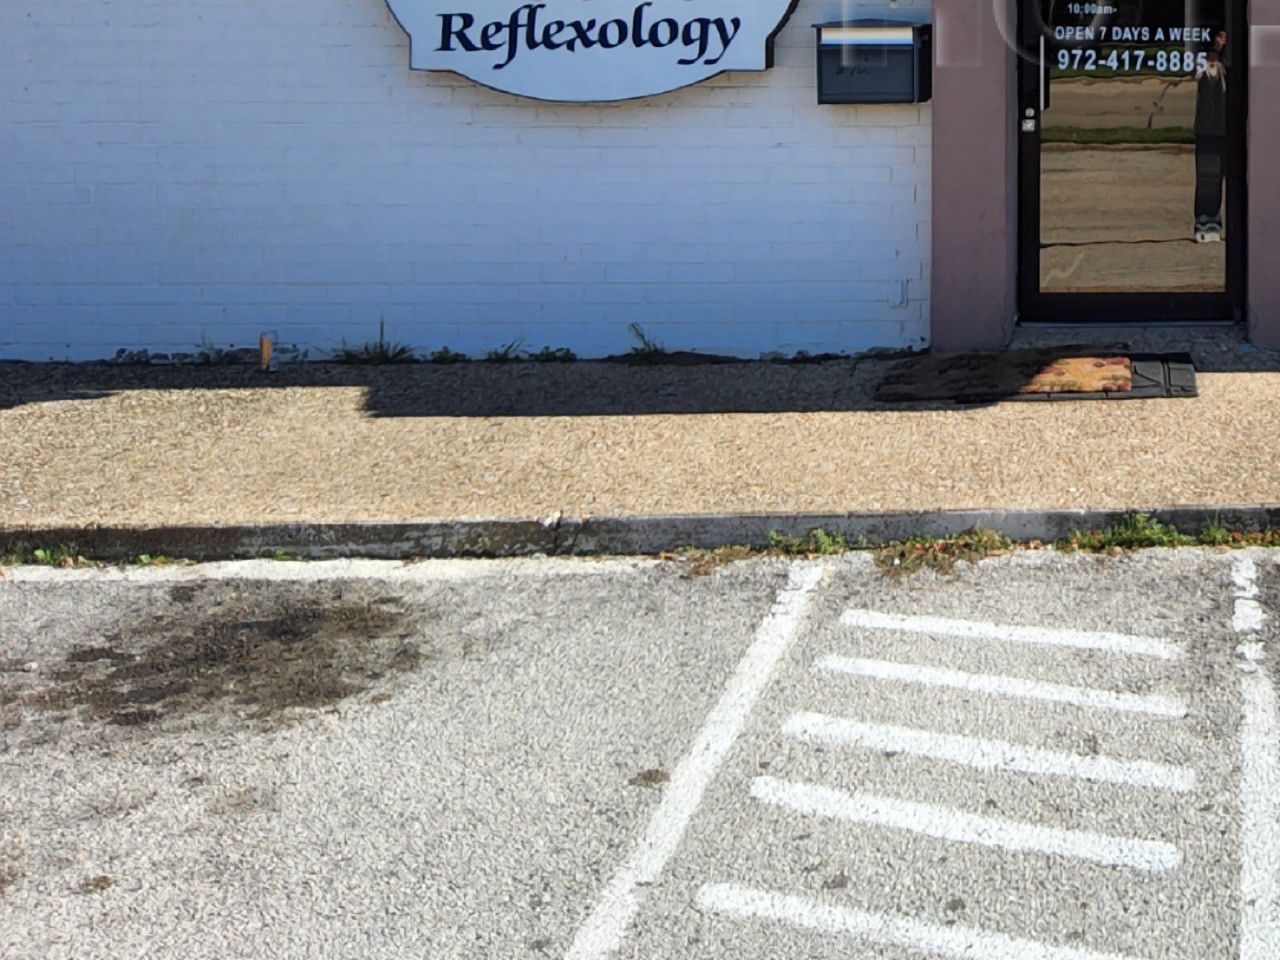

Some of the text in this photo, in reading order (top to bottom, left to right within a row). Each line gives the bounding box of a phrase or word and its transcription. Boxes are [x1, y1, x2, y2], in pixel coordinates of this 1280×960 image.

[434, 3, 740, 70] Reflexology
[1054, 26, 1211, 42] OPEN 7 DAYS A WEEK
[1057, 49, 1208, 72] 972-417-8885
